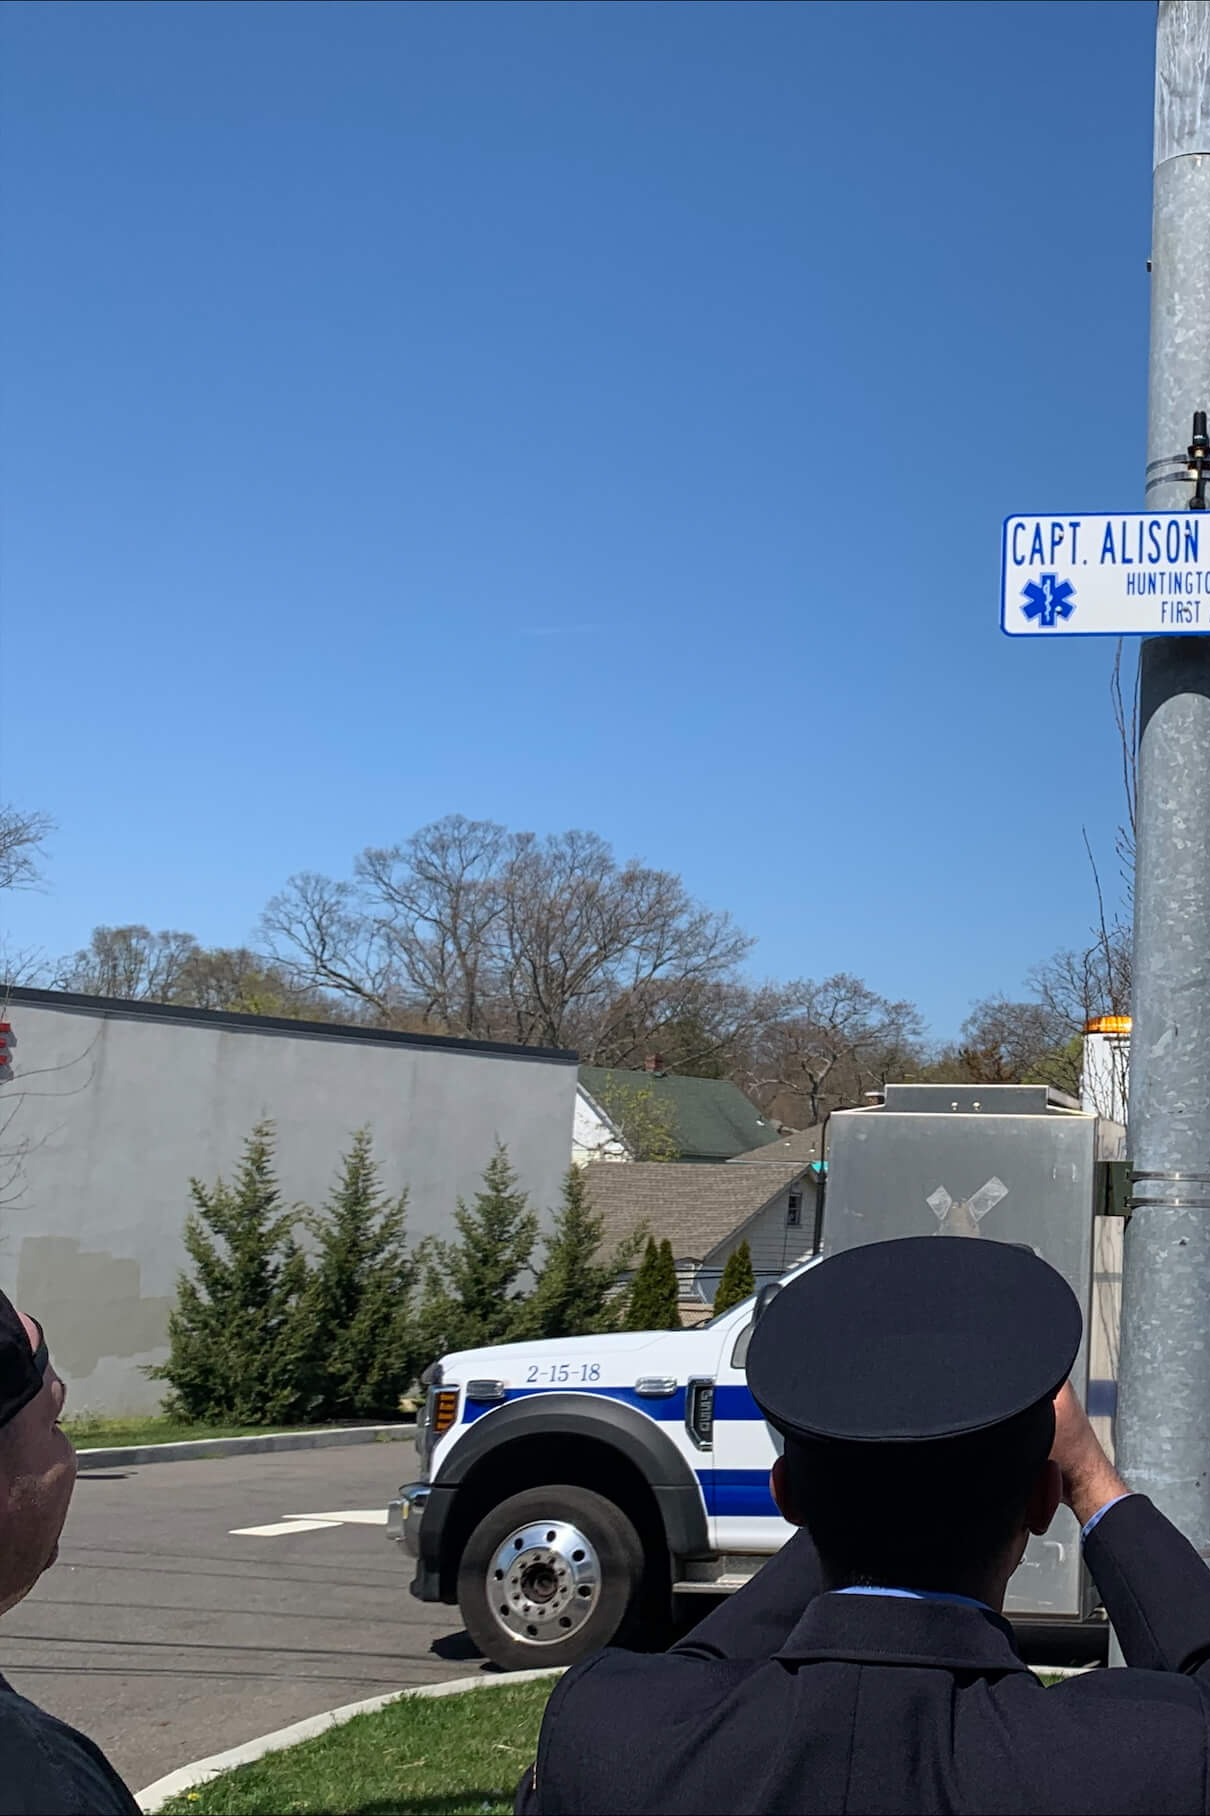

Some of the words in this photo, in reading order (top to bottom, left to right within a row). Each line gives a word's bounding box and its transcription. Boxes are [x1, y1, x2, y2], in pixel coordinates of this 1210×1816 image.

[1012, 521, 1088, 566] CAPT.
[1099, 519, 1199, 564] ALISON
[1160, 600, 1202, 624] FIRST
[526, 1363, 601, 1383] 2-15-18
